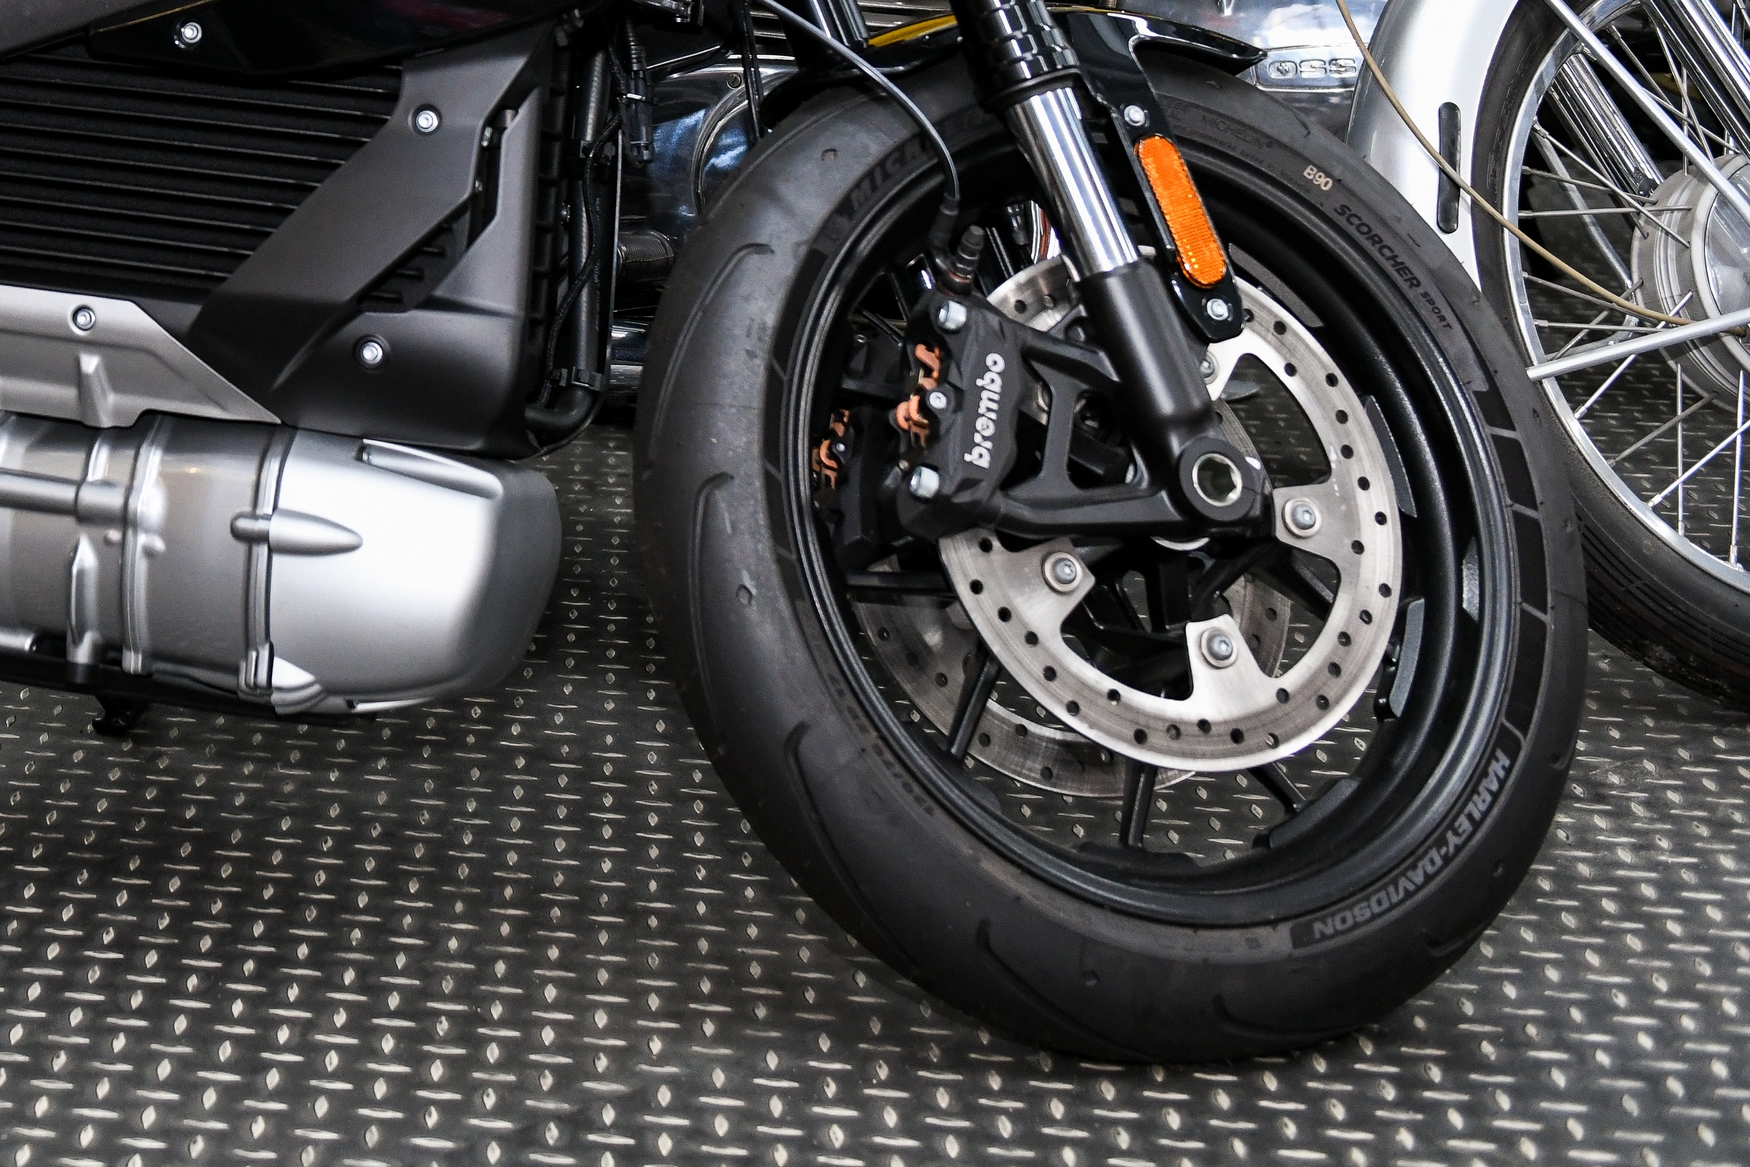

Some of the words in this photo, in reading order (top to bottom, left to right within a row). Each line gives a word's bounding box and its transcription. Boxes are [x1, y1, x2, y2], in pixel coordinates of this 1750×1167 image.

[1302, 164, 1332, 191] B90
[1333, 203, 1421, 289] SCORCHER
[1421, 290, 1454, 330] SPORT
[964, 353, 1005, 470] brembo
[1314, 748, 1511, 940] HARLEY-DAVIDSON
